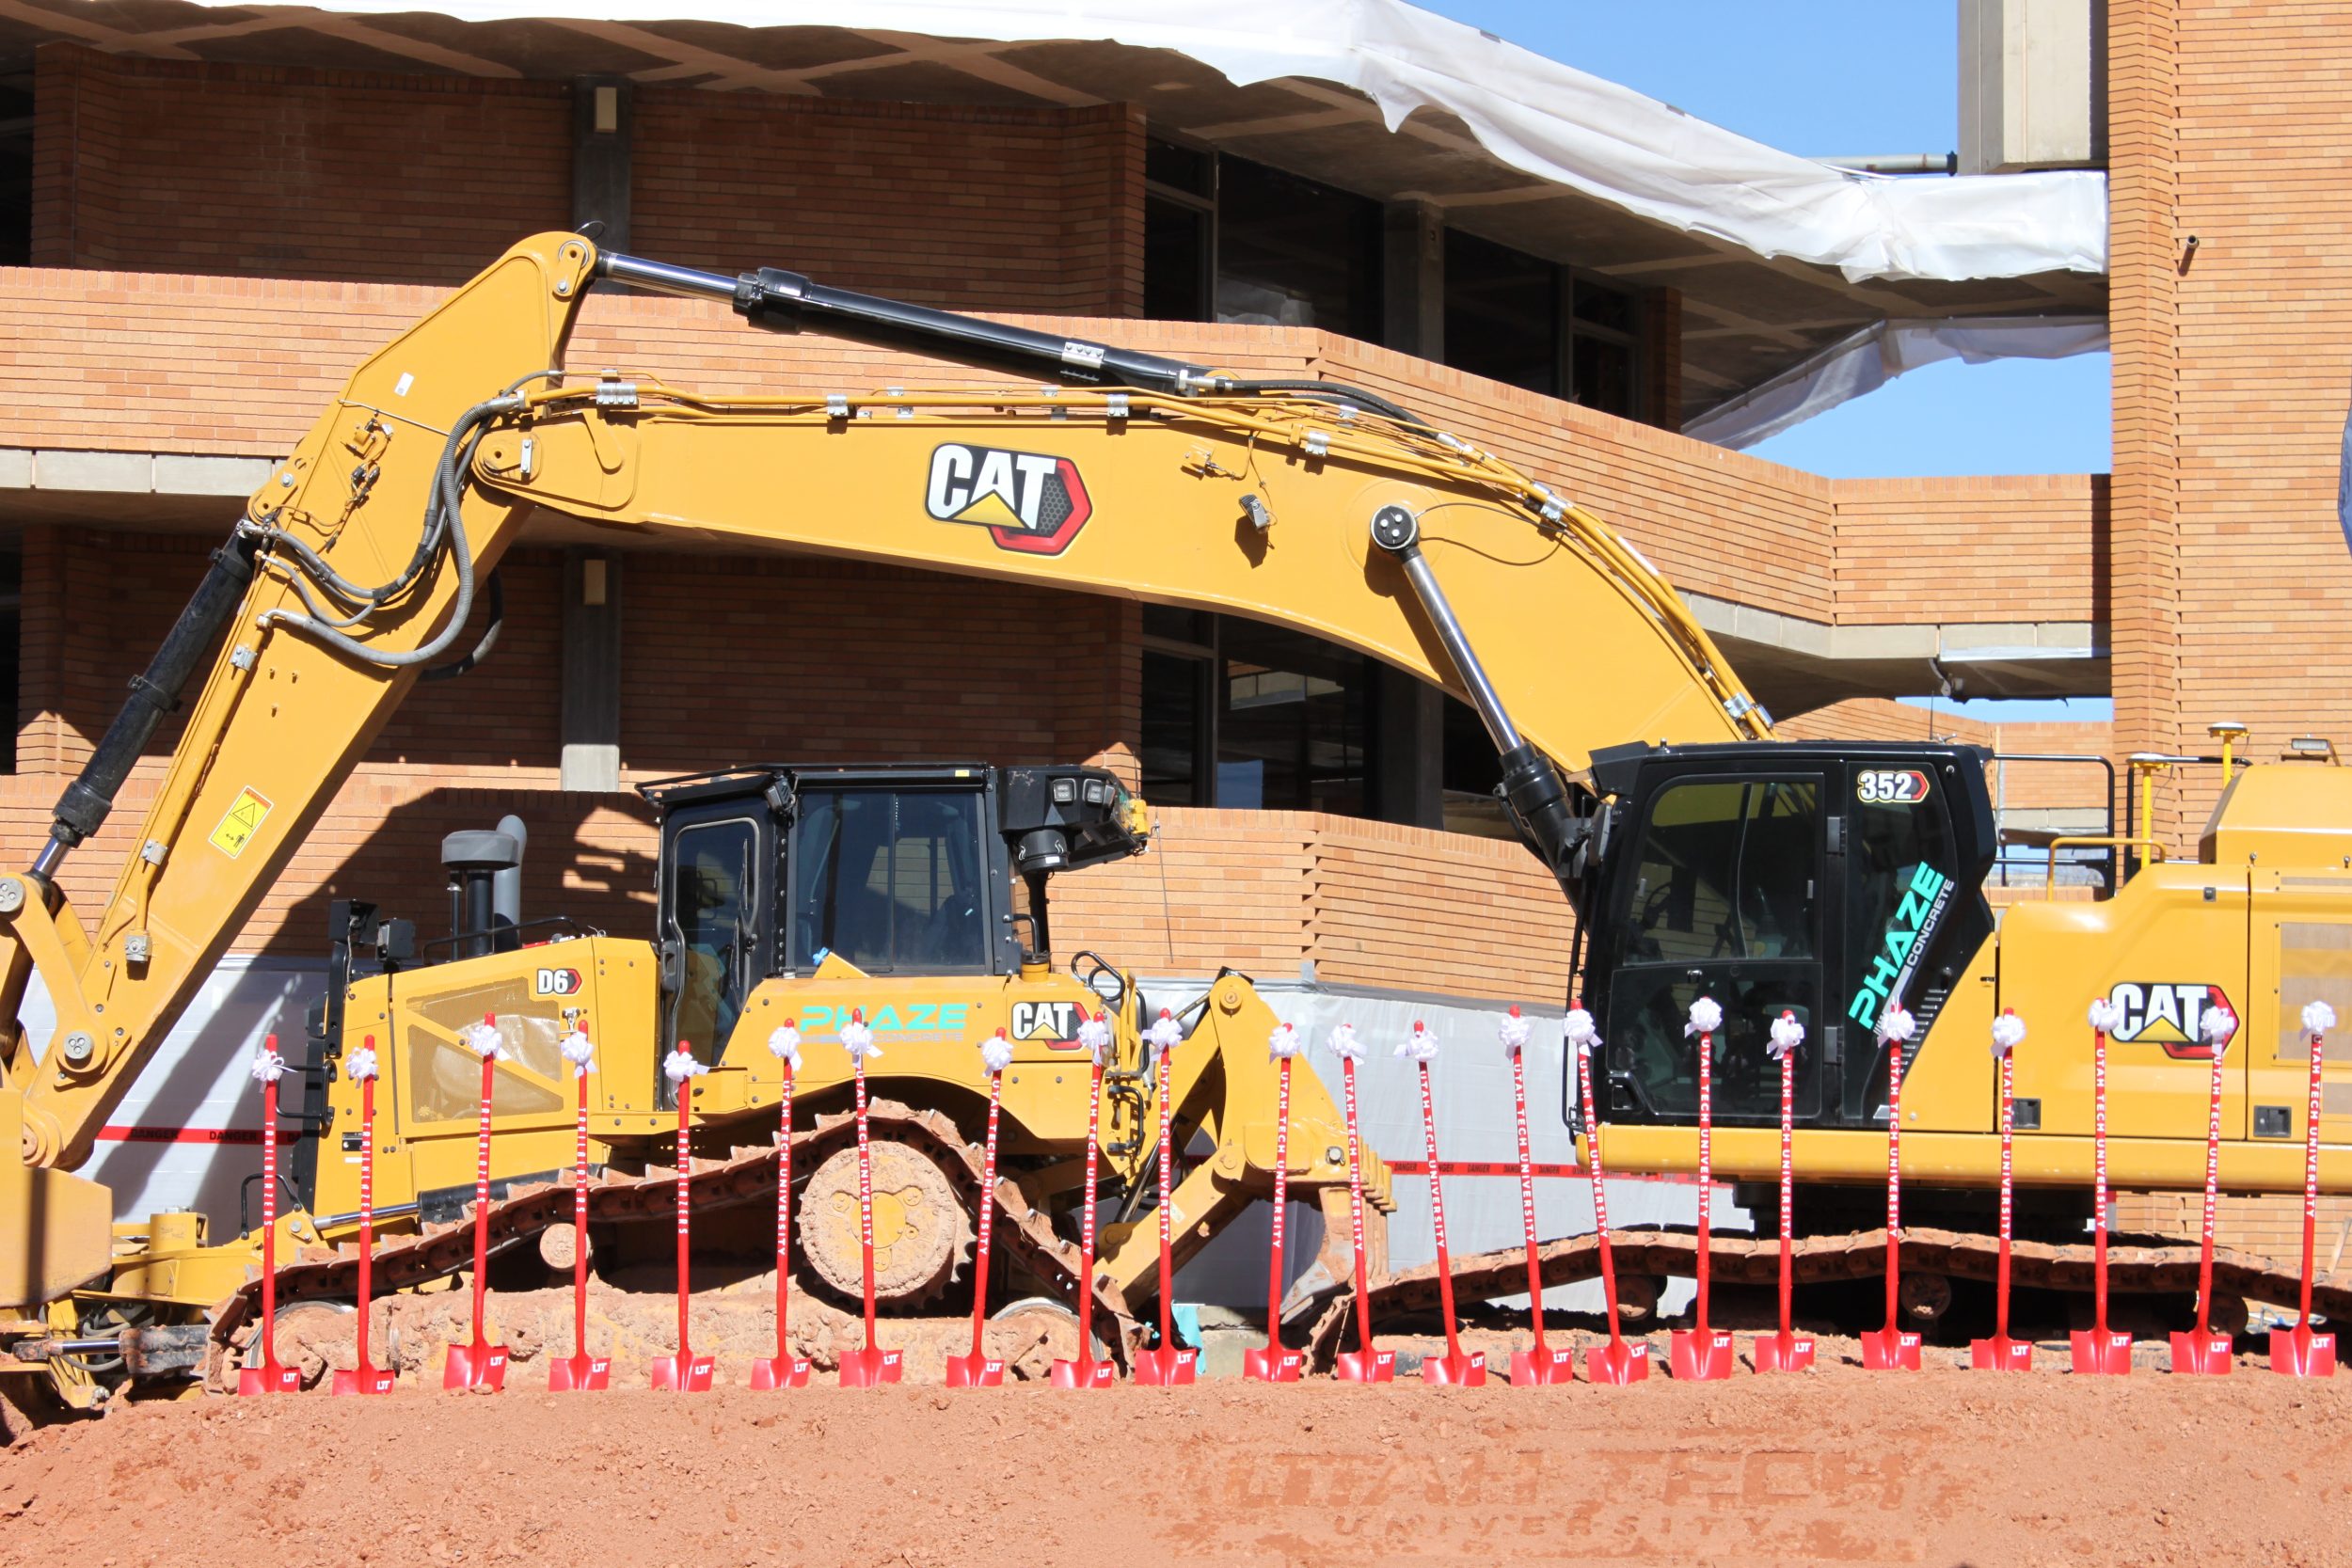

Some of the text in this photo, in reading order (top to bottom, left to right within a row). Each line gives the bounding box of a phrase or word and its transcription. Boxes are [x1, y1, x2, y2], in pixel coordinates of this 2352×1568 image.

[928, 444, 1057, 530] CAT
[1860, 772, 1913, 800] 352
[1848, 861, 1945, 1031] PHAZE
[1906, 879, 1955, 968] CONCRETE
[538, 970, 568, 993] D6
[800, 1004, 969, 1032] PHAZE
[1012, 1003, 1073, 1039] CAT
[2110, 983, 2207, 1041] CAT
[130, 1129, 257, 1141] DANGER DANGER
[782, 1080, 790, 1117] UTAH
[2097, 1048, 2106, 1227] UTAH TECH UNIVERSITY
[2305, 1035, 2324, 1217] UTAH TECH UNIVERSITY
[855, 1069, 872, 1245] UTAH TECH UNIVERSITY
[980, 1080, 999, 1254] UTAH TECH UNIVERSITY
[1083, 1079, 1099, 1254] UTAH TECH UNIVERSITY
[1273, 1071, 1289, 1247] UTAH TECH UNIVERSITY
[1344, 1074, 1362, 1250] UTAH TECH UNIVERSITY
[1394, 1163, 1417, 1171] DANGER
[1468, 1164, 1490, 1173] DANGER
[1538, 1166, 1560, 1175] DANGER
[1419, 1070, 1445, 1247] UTAH TECH UNIVERSITY
[1513, 1063, 1534, 1242] UTAH TECH UNIVERSITY
[1579, 1060, 1609, 1238] UTAH TECH UNIVERSITY
[2204, 1056, 2221, 1237] UTAH TECH UNIVERSITY
[777, 1168, 787, 1255] UNIVERSITY
[1782, 1148, 1790, 1238] UNIVERSITY
[1889, 1147, 1898, 1236] UNIVERSITY
[2002, 1149, 2010, 1239] UNIVERSITY
[1587, 1449, 1904, 1509] TECH
[1334, 1514, 1772, 1538] UNIVERSITY
